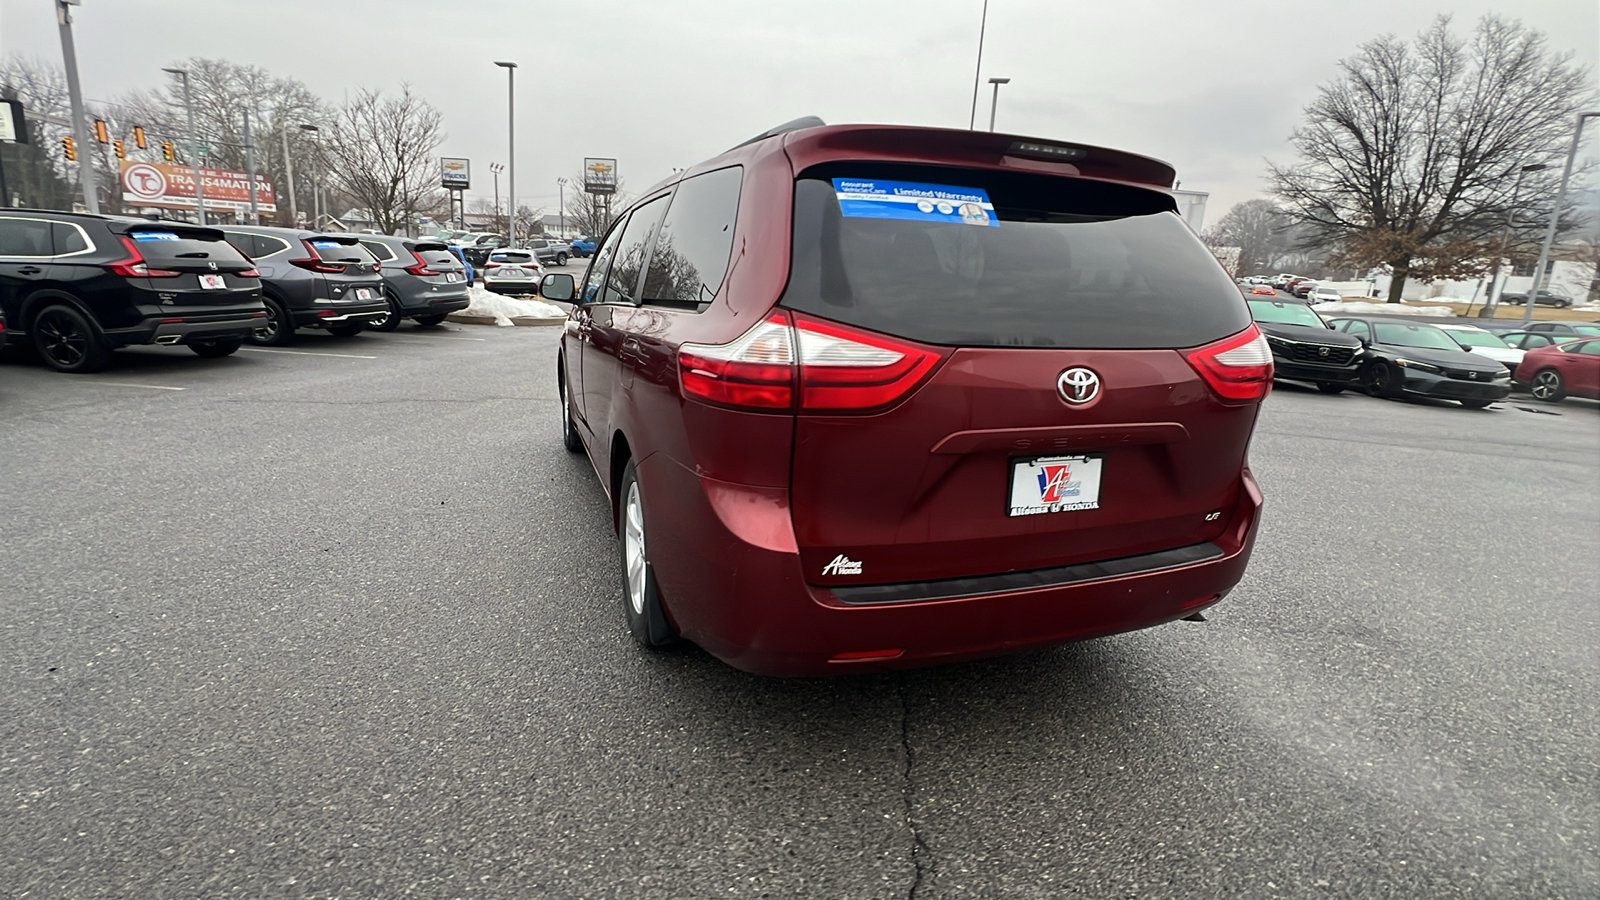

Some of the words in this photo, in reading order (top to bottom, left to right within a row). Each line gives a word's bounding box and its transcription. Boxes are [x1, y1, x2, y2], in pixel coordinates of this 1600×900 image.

[893, 187, 935, 198] Limited
[935, 190, 983, 203] Warranty
[1063, 502, 1099, 511] HONDA
